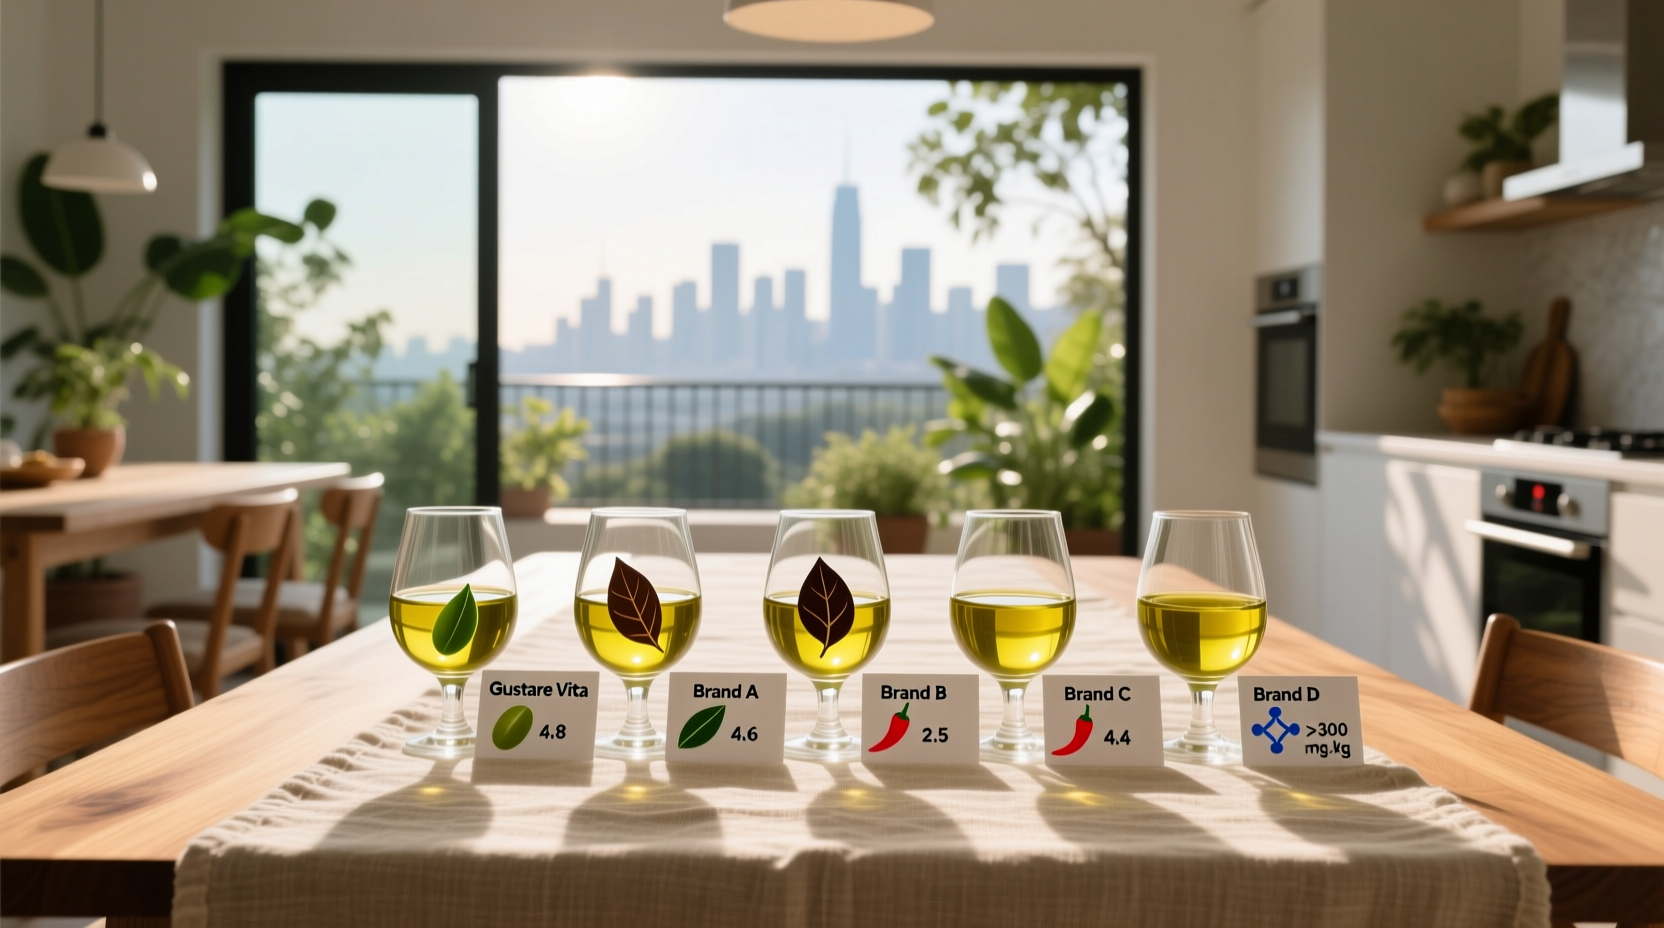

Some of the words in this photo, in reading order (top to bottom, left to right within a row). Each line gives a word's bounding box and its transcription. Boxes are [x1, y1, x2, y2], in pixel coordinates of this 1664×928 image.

[489, 680, 553, 697] Gustare
[555, 680, 589, 698] Vita
[693, 683, 741, 699] Brand
[745, 684, 760, 700] A
[880, 684, 931, 700] Brand
[935, 684, 948, 701] B
[1064, 685, 1114, 702] Brand
[1118, 686, 1132, 702] C
[1253, 686, 1303, 702] Brand
[1306, 686, 1321, 702] D
[538, 723, 567, 740] 4.8
[730, 725, 759, 742] 4.6
[921, 726, 949, 744] 2.5
[1103, 729, 1132, 746] 4.4
[1305, 721, 1349, 738] >300
